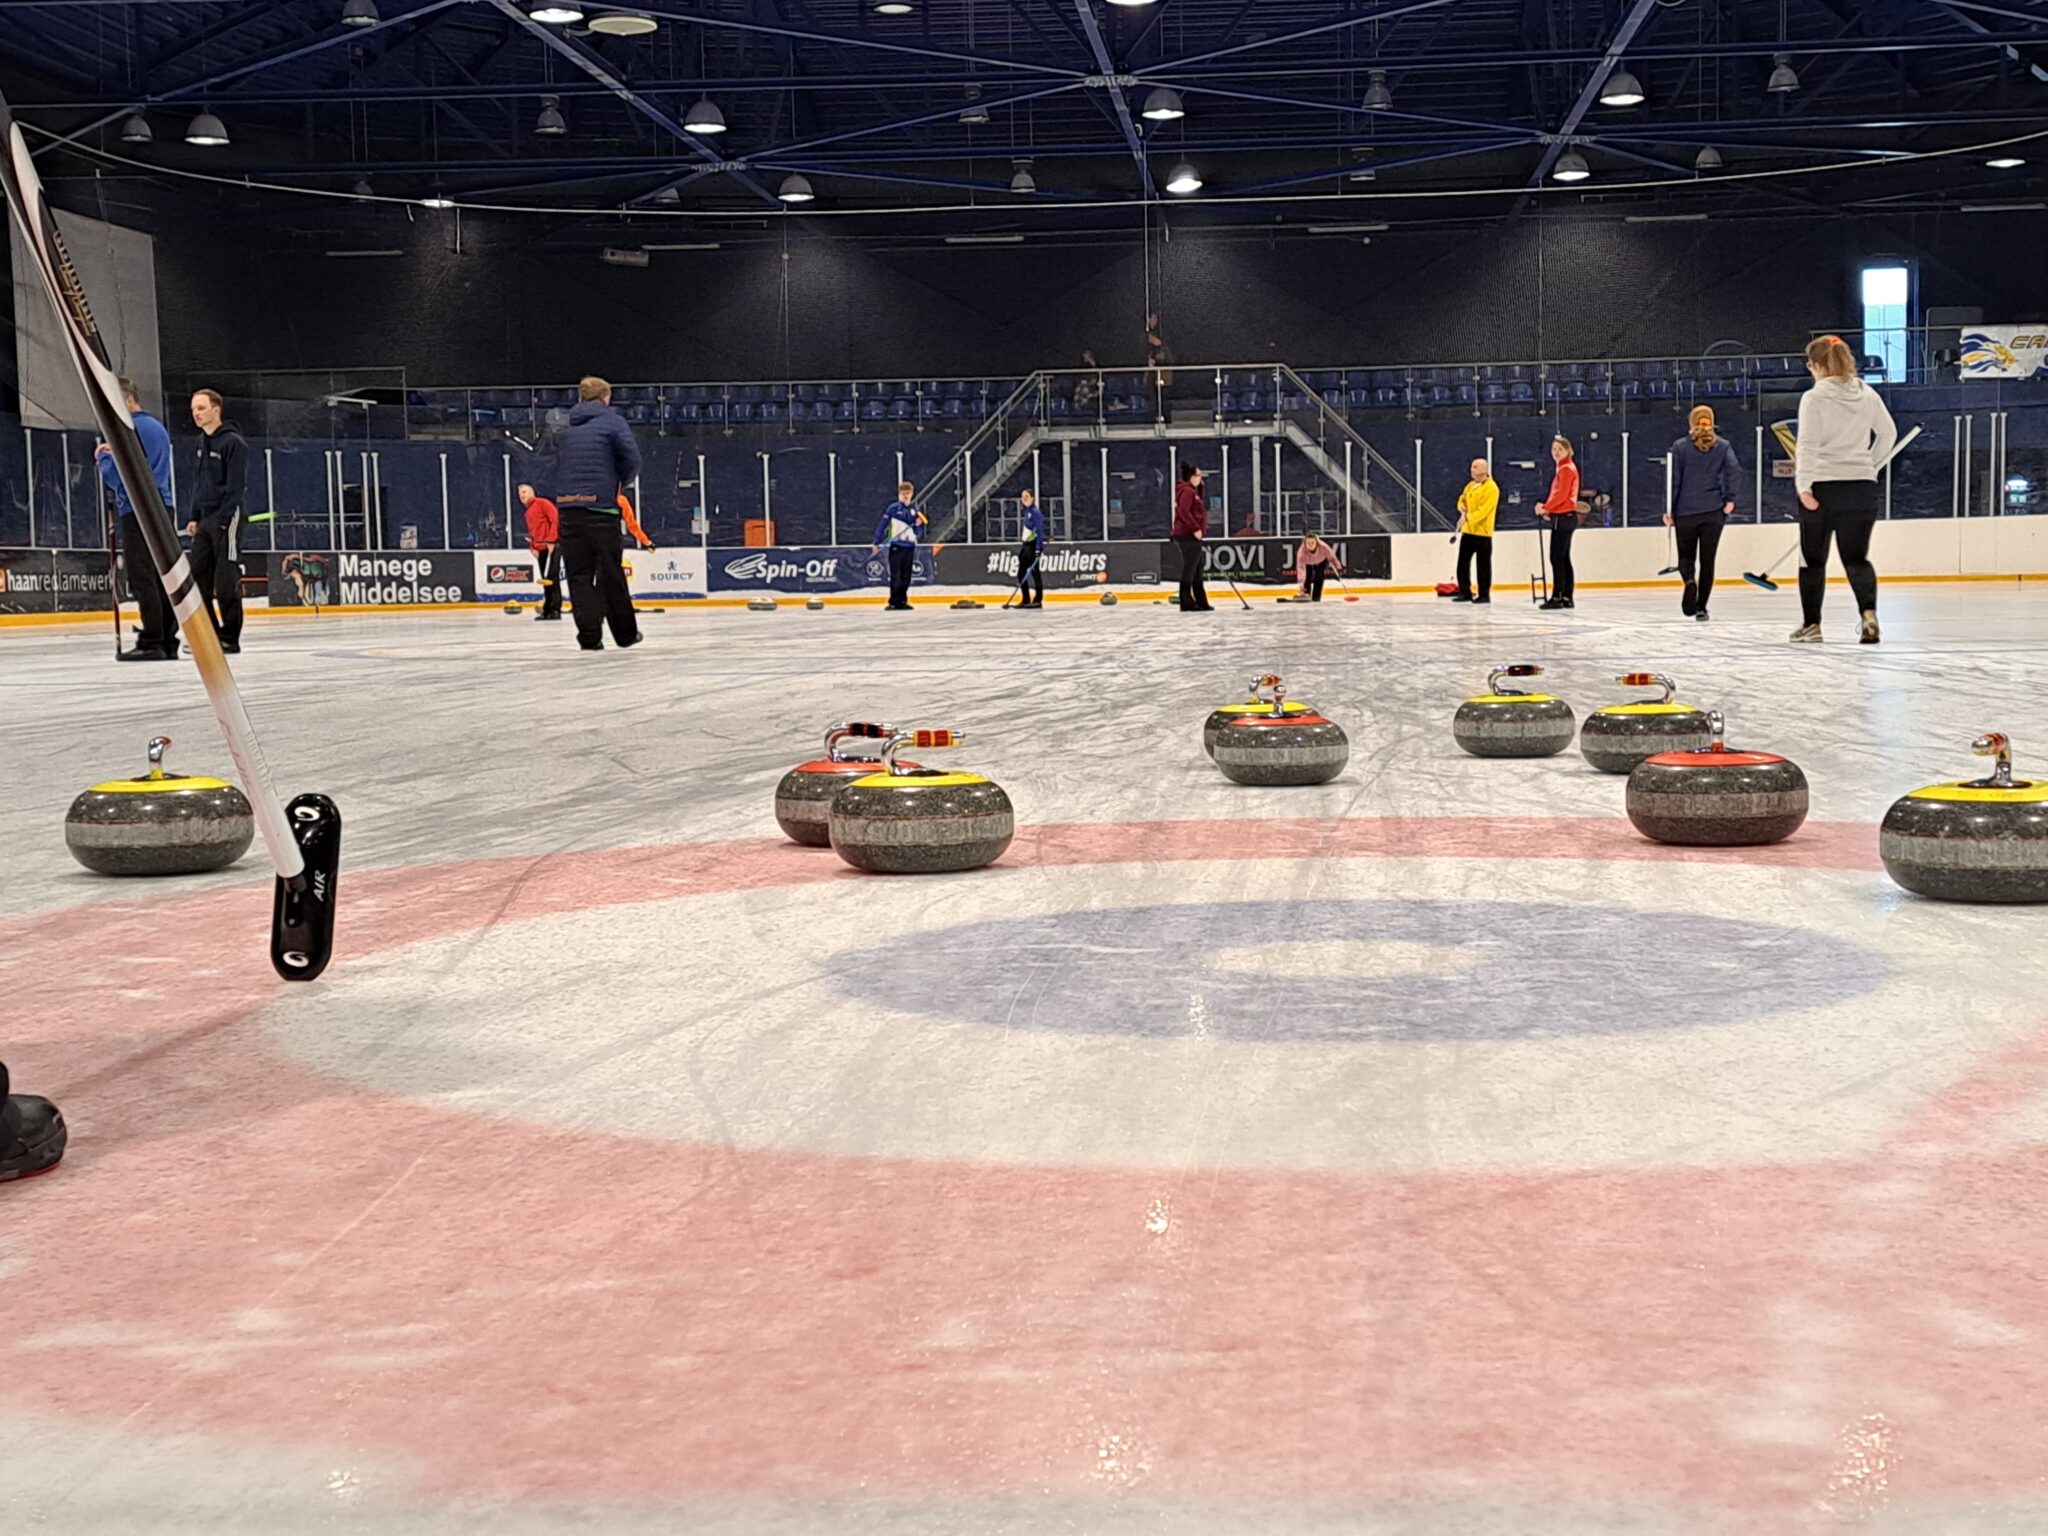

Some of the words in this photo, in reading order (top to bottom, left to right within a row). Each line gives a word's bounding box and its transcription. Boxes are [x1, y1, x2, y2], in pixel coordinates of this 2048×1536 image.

[2010, 334, 2048, 349] CA
[339, 554, 432, 582] Manege
[987, 550, 1108, 577] #ligbuilders
[1201, 544, 1265, 571] JOVI
[1282, 542, 1347, 569] JI
[650, 572, 694, 581] SOURCY
[756, 558, 838, 584] Spin-Off
[341, 581, 462, 605] Middelsee
[313, 869, 327, 902] AIR
